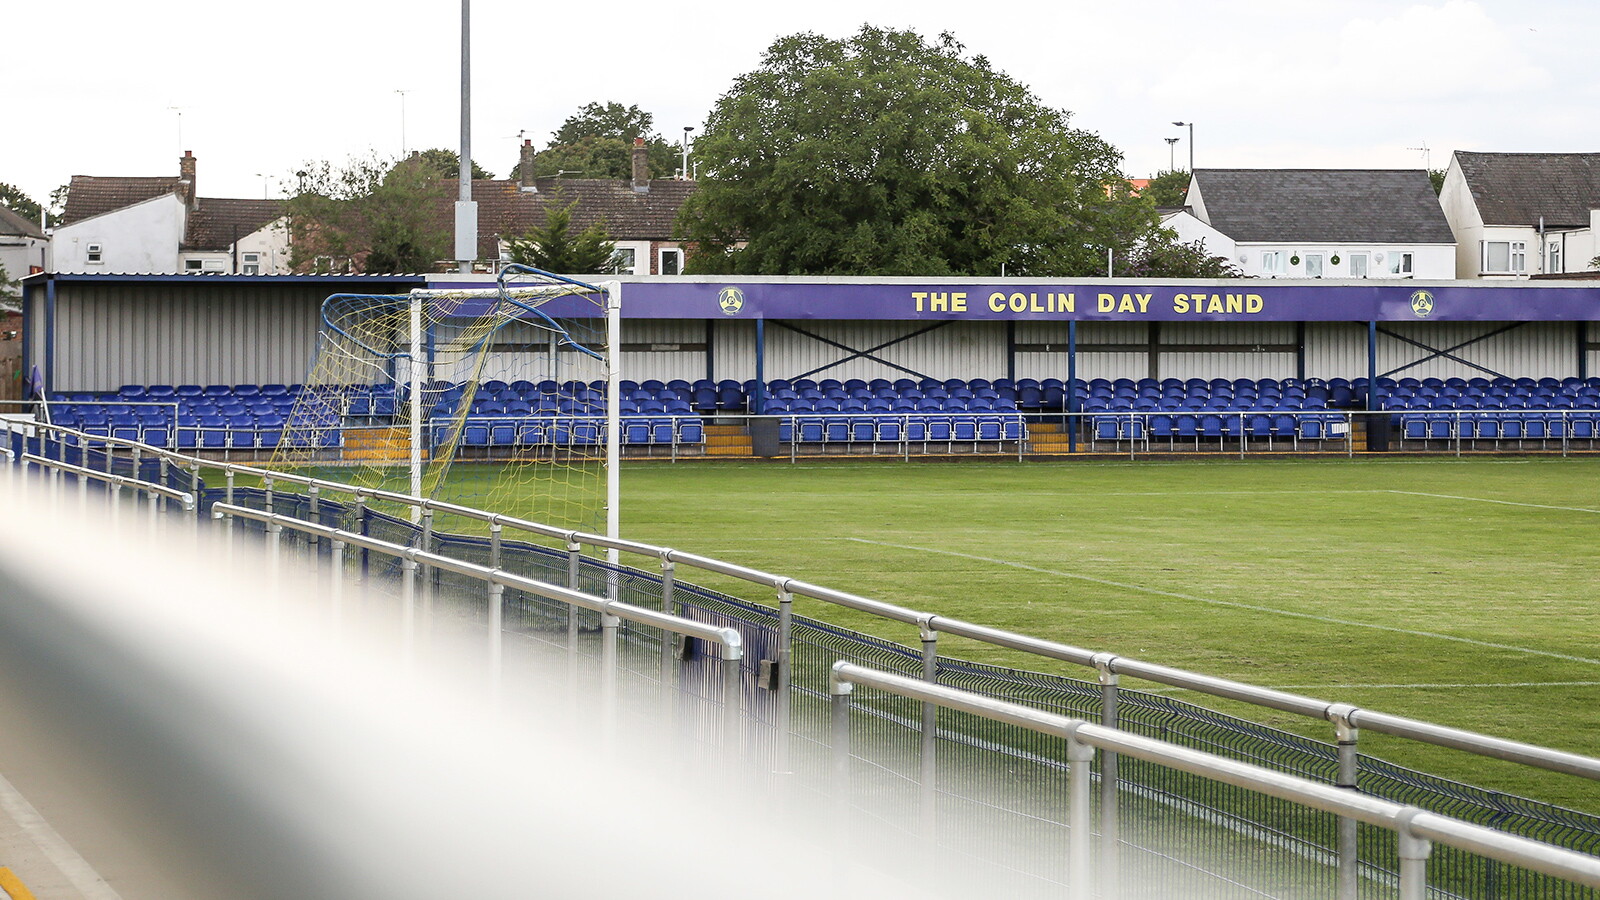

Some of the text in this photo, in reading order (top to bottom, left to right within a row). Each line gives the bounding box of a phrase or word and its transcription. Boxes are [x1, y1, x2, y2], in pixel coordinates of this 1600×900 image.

[911, 292, 1264, 314] THE COLIN DAY STAND
